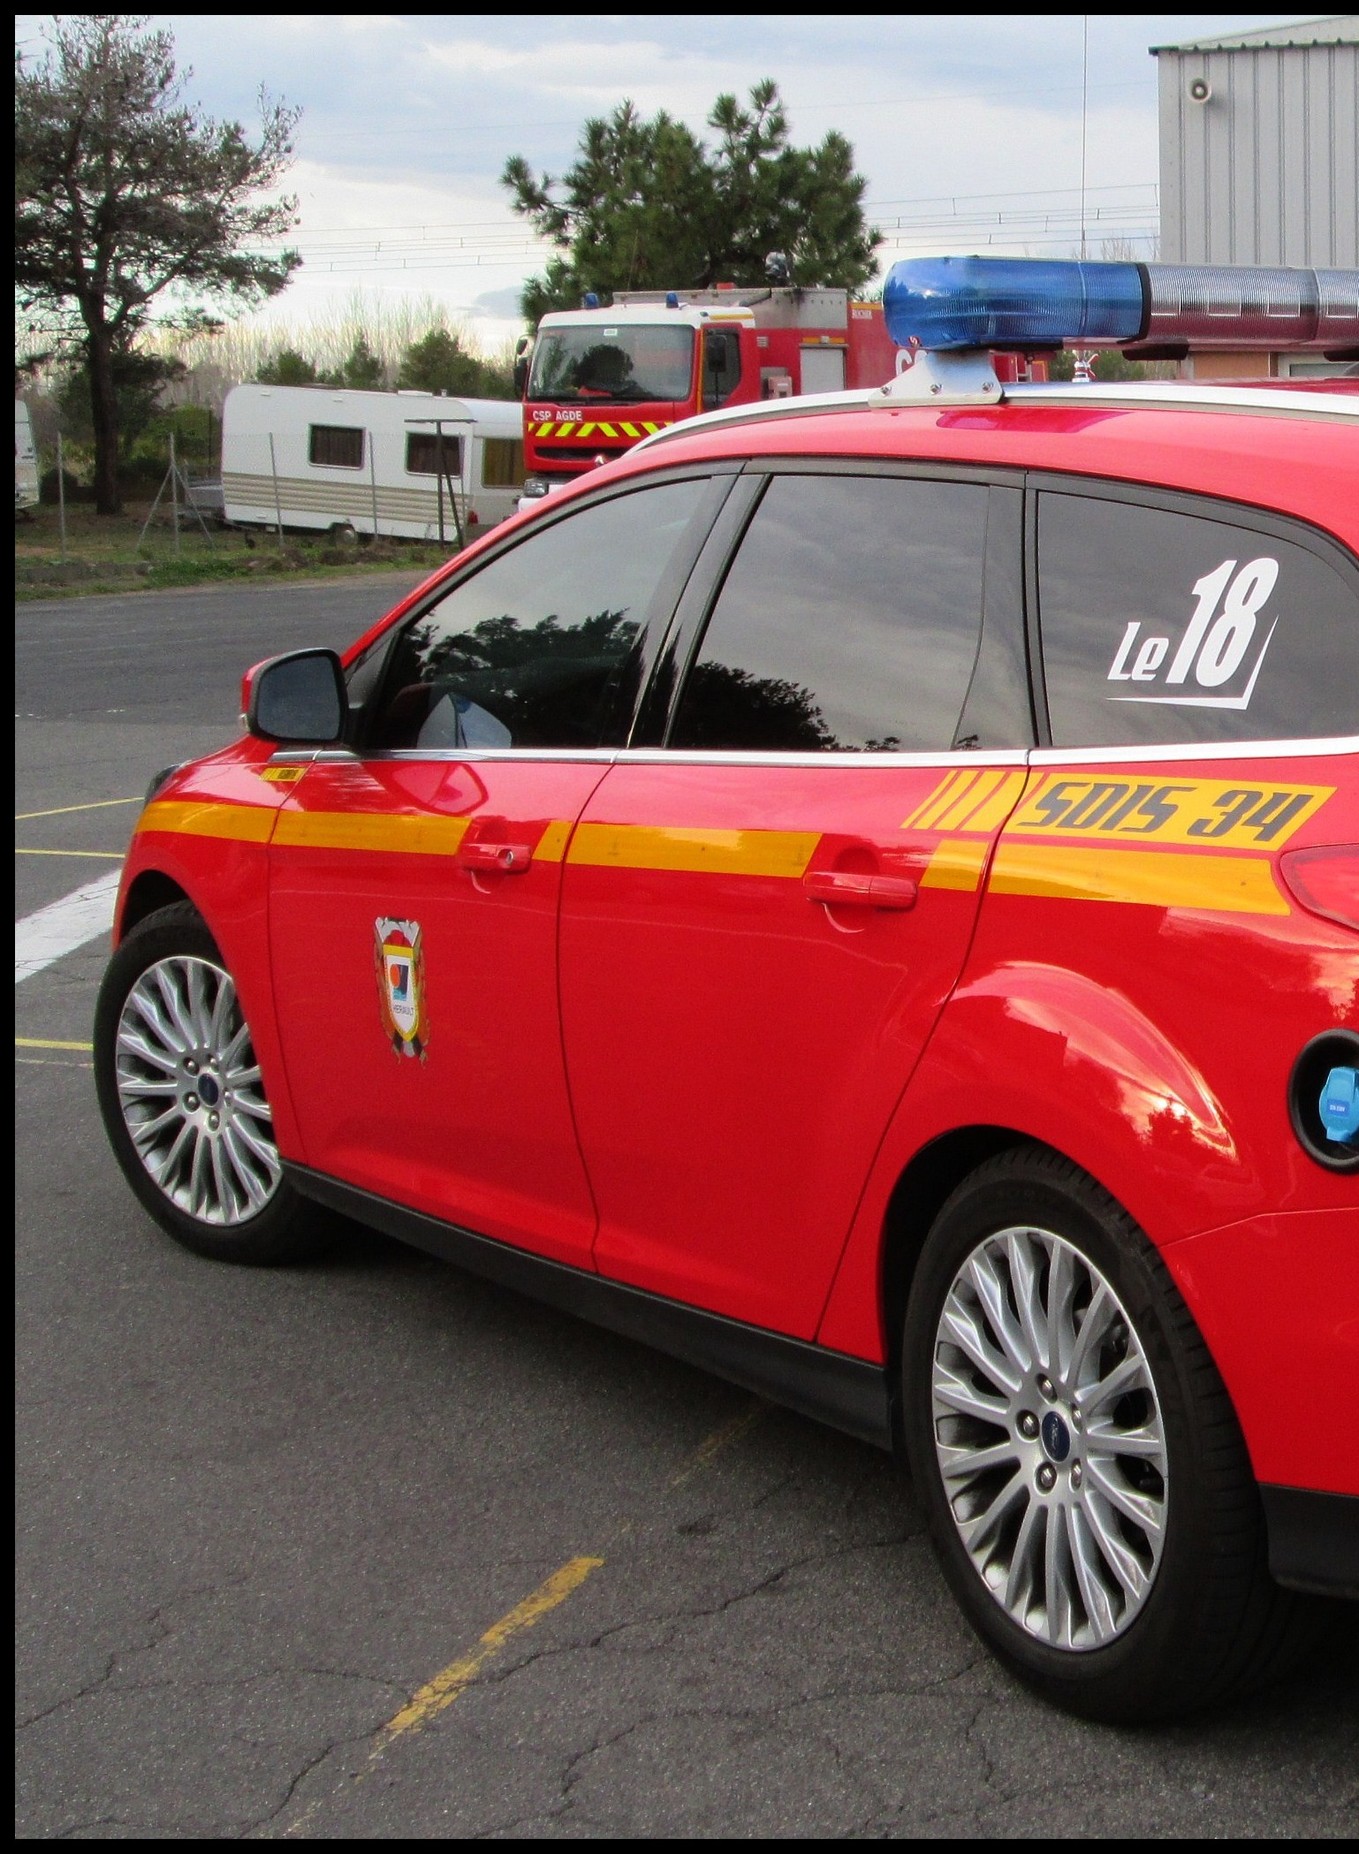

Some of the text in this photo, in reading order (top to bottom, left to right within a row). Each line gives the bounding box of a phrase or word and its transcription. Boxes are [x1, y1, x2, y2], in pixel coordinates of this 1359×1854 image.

[532, 410, 583, 421] CSP AGDE
[1107, 557, 1279, 687] Le 18
[1016, 781, 1314, 843] SDIS 34
